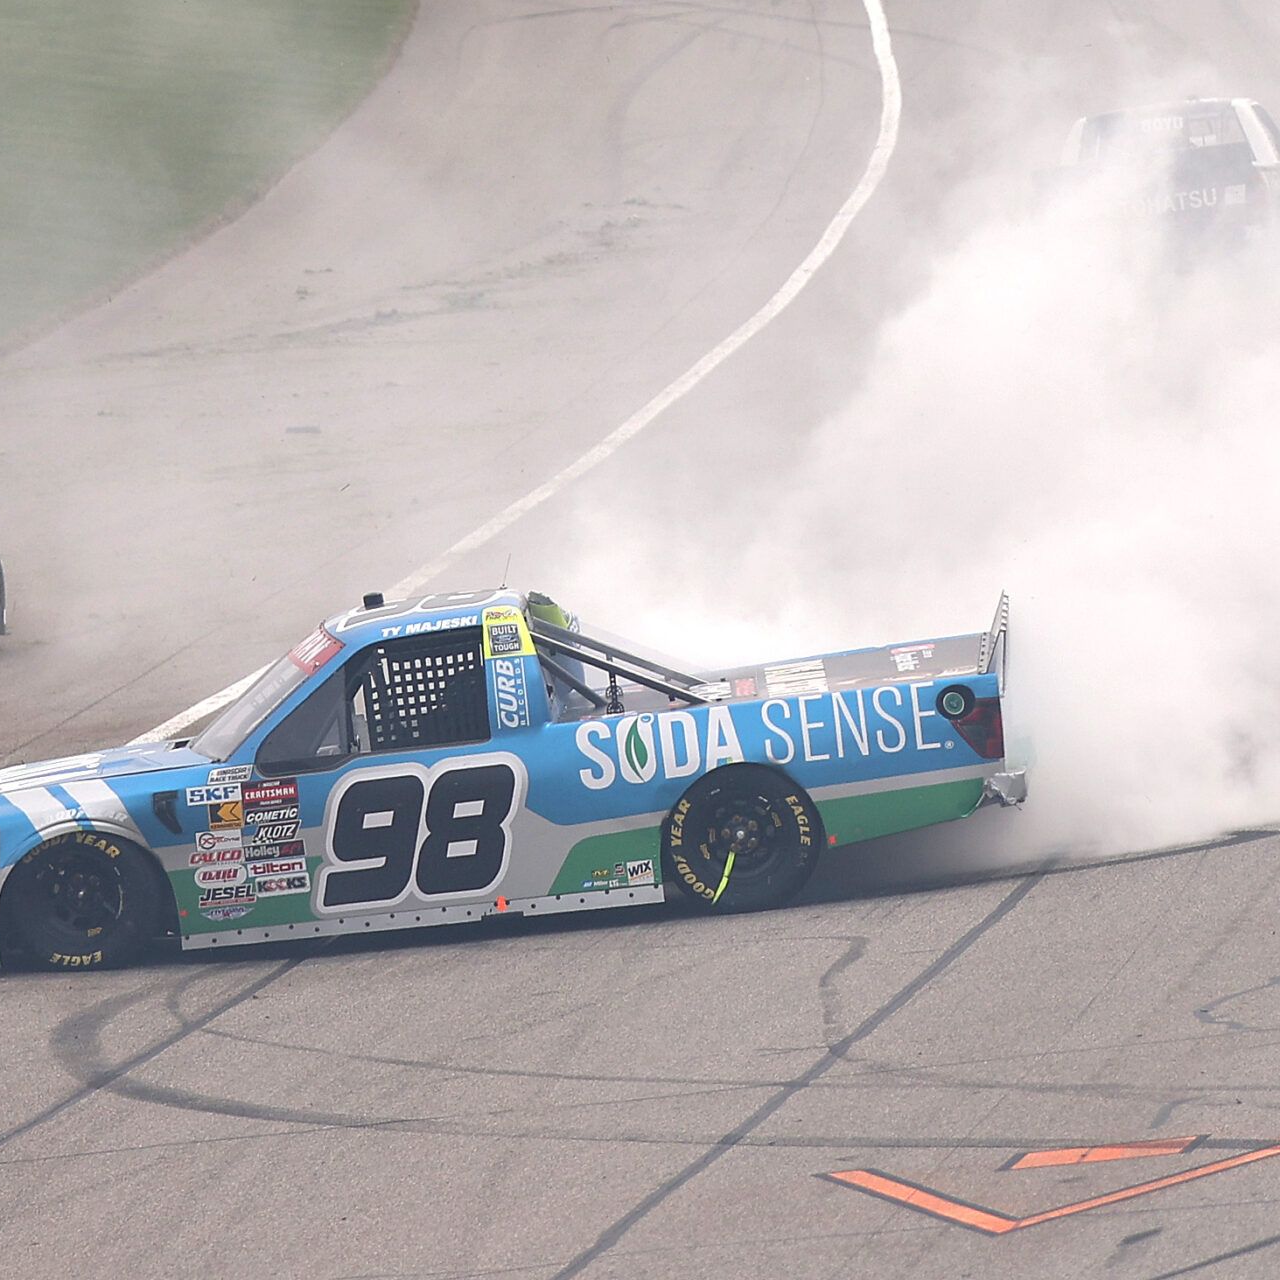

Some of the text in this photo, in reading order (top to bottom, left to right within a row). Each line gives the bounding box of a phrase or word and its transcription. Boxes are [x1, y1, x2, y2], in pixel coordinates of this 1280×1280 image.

[381, 625, 403, 638] TY
[405, 615, 478, 635] MAJESKI
[491, 625, 517, 636] BUILT
[493, 642, 520, 652] TOUGH
[496, 659, 520, 729] CURB
[575, 681, 942, 790] SODA SENSE
[188, 785, 239, 803] SKF
[244, 786, 296, 801] CRAFTSMAN
[246, 807, 298, 823] COMETIC
[785, 795, 812, 847] EAGLE
[258, 823, 297, 840] KLOTZ
[319, 758, 520, 910] 98
[189, 849, 242, 865] CALICO
[245, 845, 280, 861] Holley
[250, 861, 303, 875] tilton
[628, 860, 652, 878] WIX
[257, 876, 308, 893] KOOKS
[200, 885, 256, 902] JESEL
[49, 950, 104, 967] EAGLE
